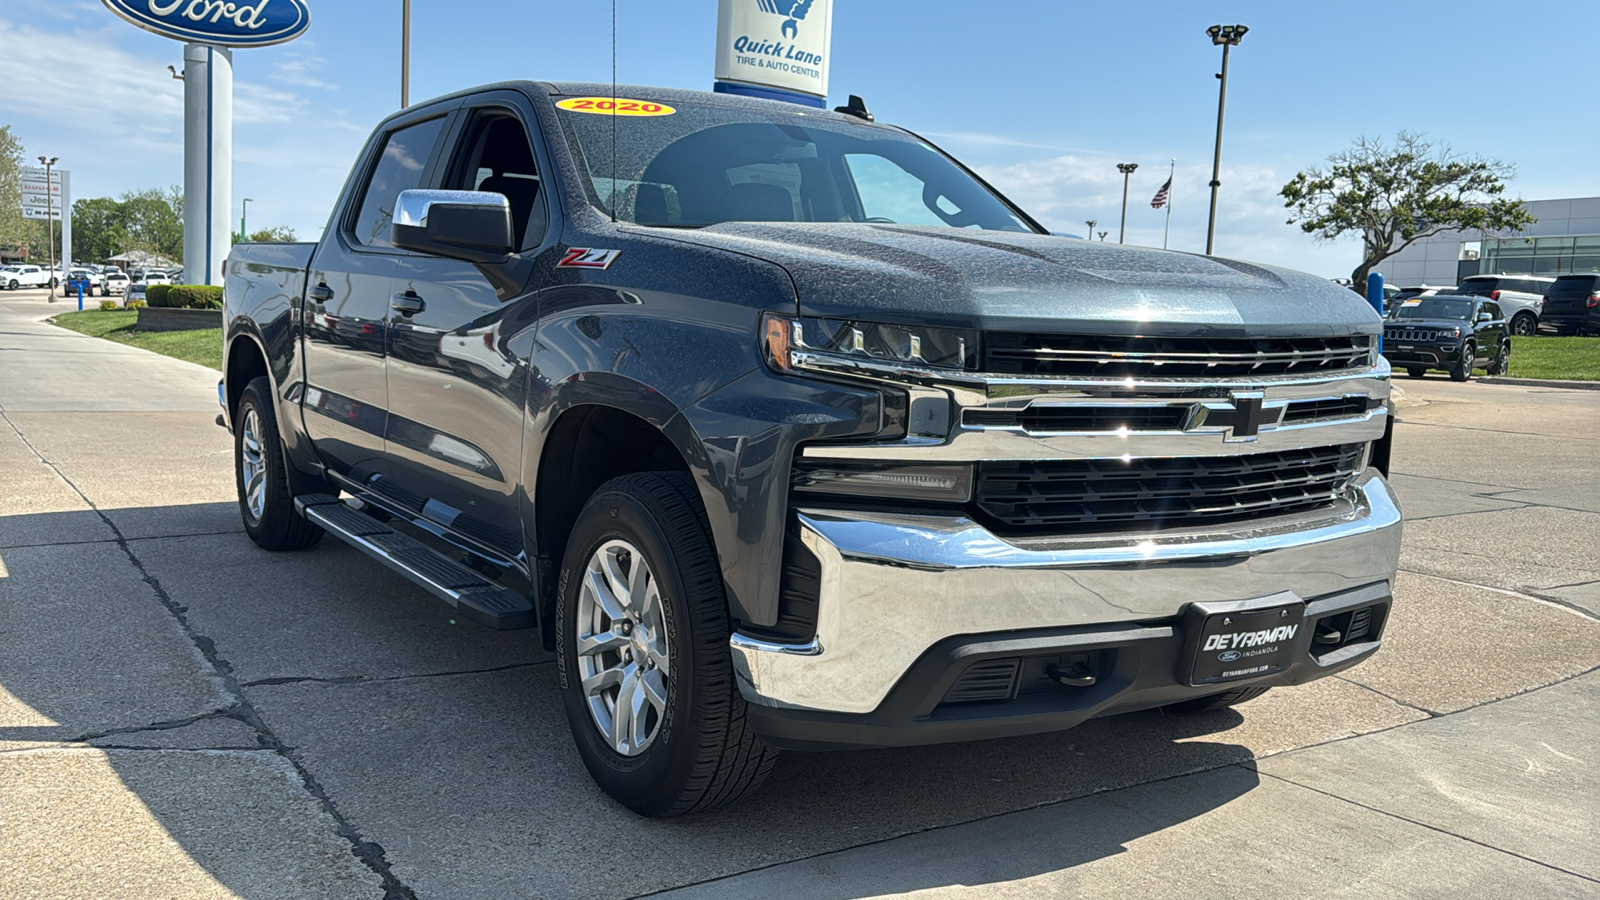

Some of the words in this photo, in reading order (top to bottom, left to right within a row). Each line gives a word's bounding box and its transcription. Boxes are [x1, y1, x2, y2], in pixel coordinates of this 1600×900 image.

[733, 35, 785, 57] Quick
[785, 45, 822, 65] Lane
[736, 55, 756, 67] TIRE
[758, 59, 764, 67] &
[765, 61, 789, 72] AUTO
[790, 65, 820, 79] CENTER
[571, 100, 662, 113] 2020
[556, 247, 621, 270] Z71
[556, 568, 570, 690] GENERAL
[1203, 624, 1299, 651] DEYARMAN
[1221, 651, 1237, 660] Ford
[1242, 645, 1279, 658] INDIANOLA
[1222, 664, 1269, 677] DEYARMANFORD.COM
